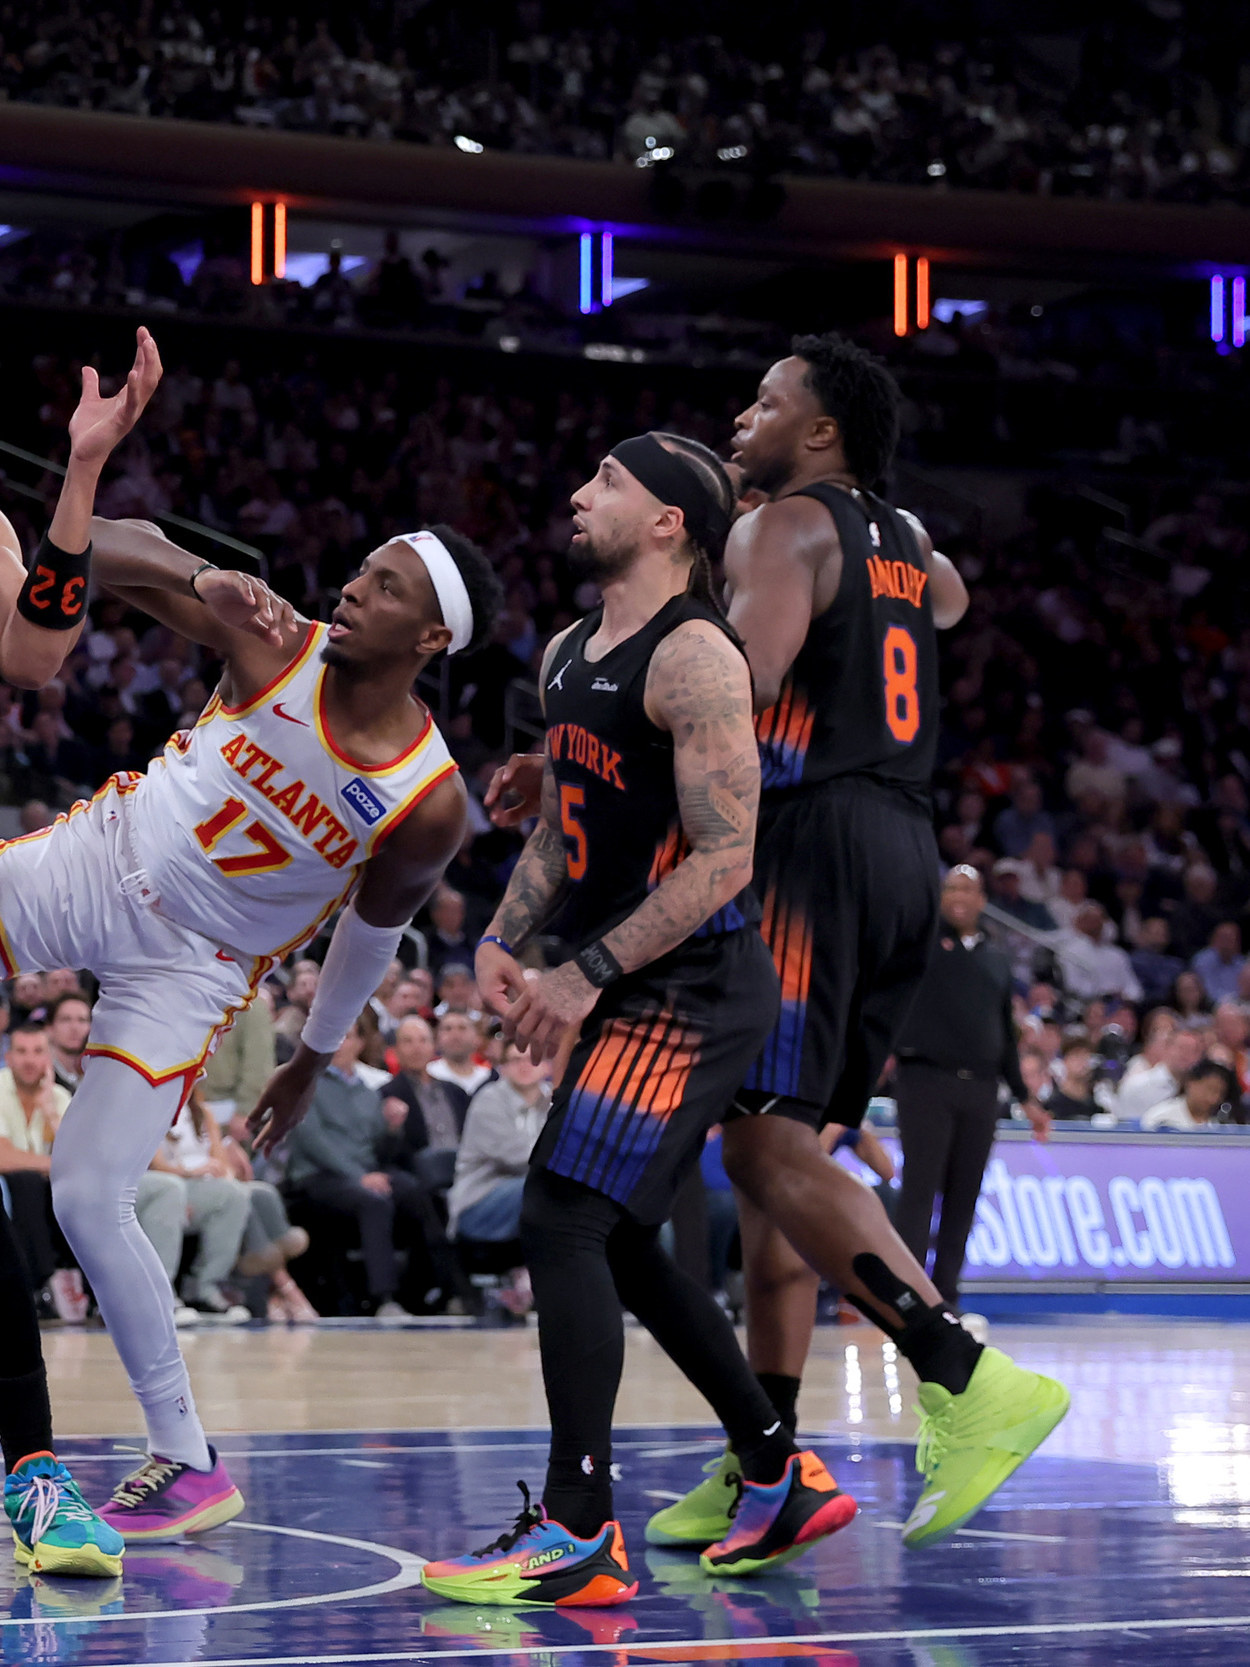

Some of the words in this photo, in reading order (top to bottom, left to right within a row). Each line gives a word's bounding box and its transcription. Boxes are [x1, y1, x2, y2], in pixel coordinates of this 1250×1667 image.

[29, 564, 85, 615] 32
[883, 622, 920, 745] 8
[567, 723, 625, 790] YORK
[193, 795, 293, 877] 17
[220, 733, 359, 869] ATLANTA
[346, 783, 380, 818] paze
[560, 782, 587, 882] 5
[580, 944, 613, 982] MOM
[965, 1158, 1236, 1268] store.com
[527, 1548, 564, 1570] AND
